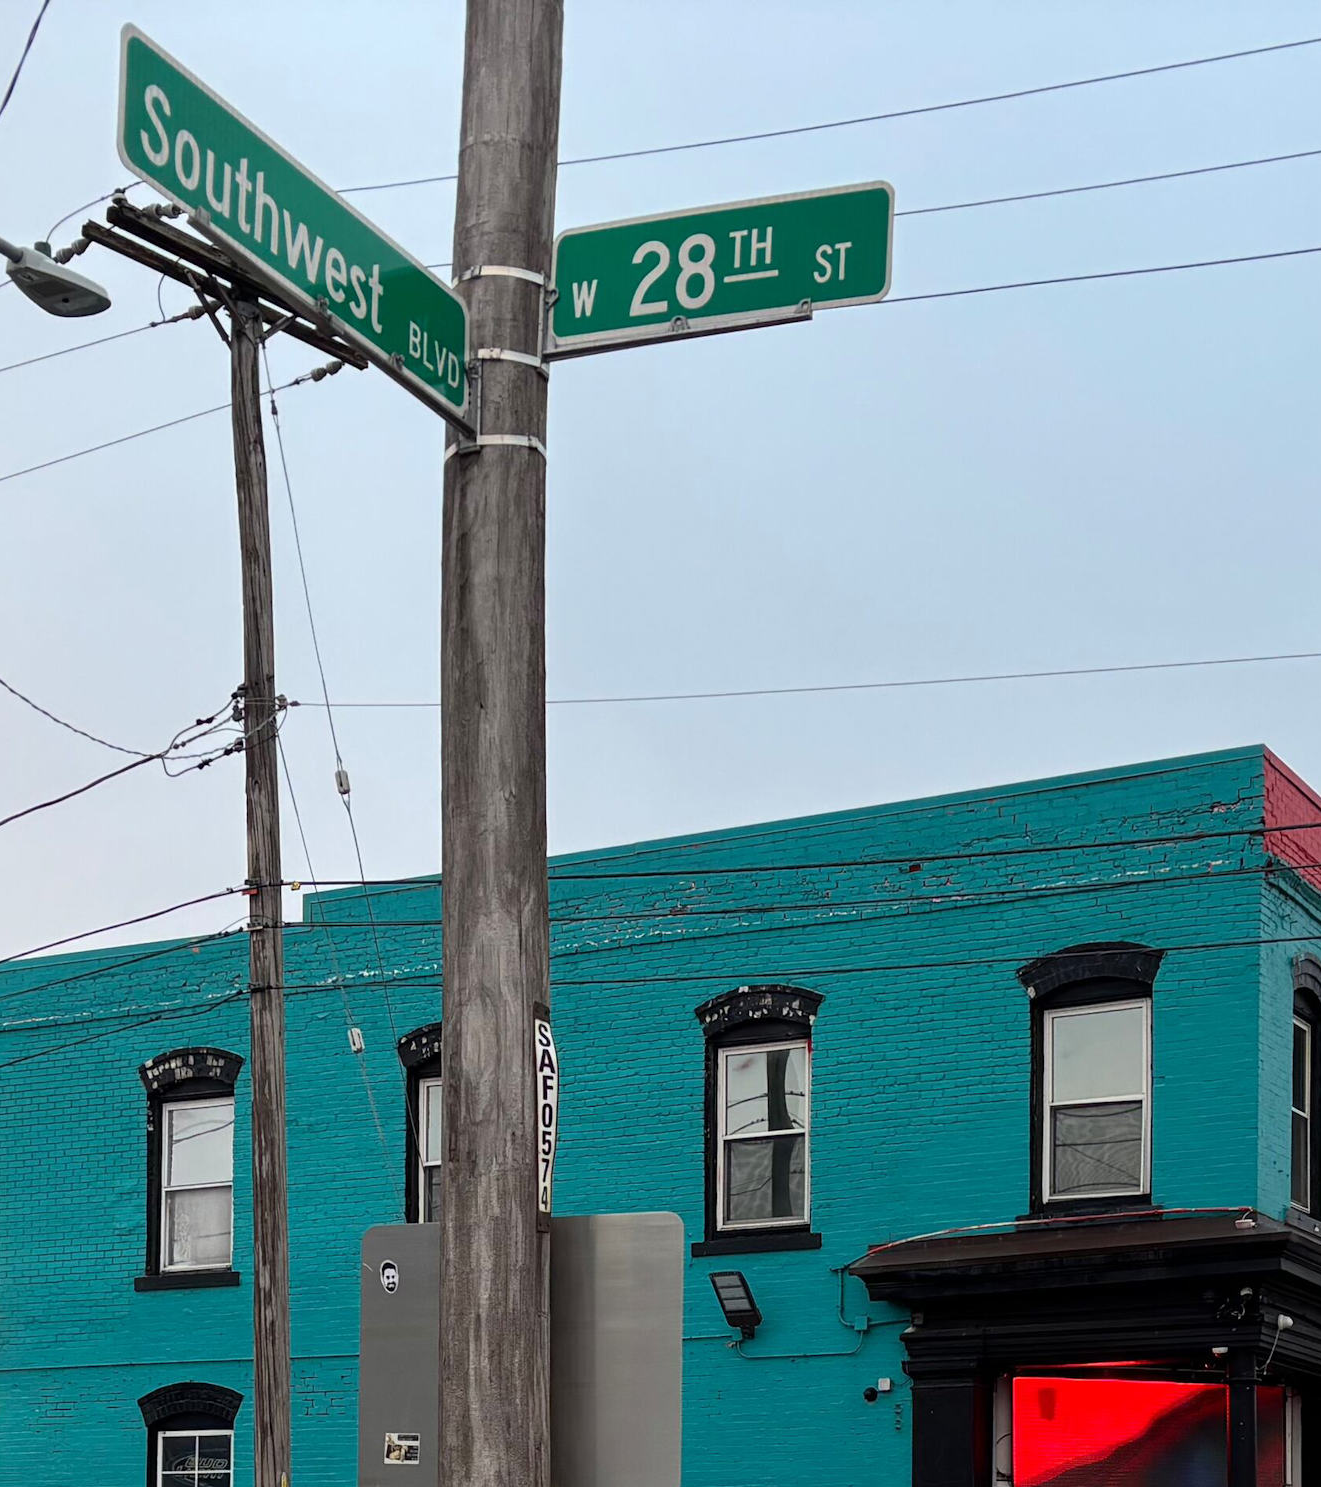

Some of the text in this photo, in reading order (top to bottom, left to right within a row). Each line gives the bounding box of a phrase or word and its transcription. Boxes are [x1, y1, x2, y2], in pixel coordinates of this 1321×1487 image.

[140, 84, 461, 389] Southwest BLVD
[572, 278, 598, 318] W
[813, 241, 853, 284] ST
